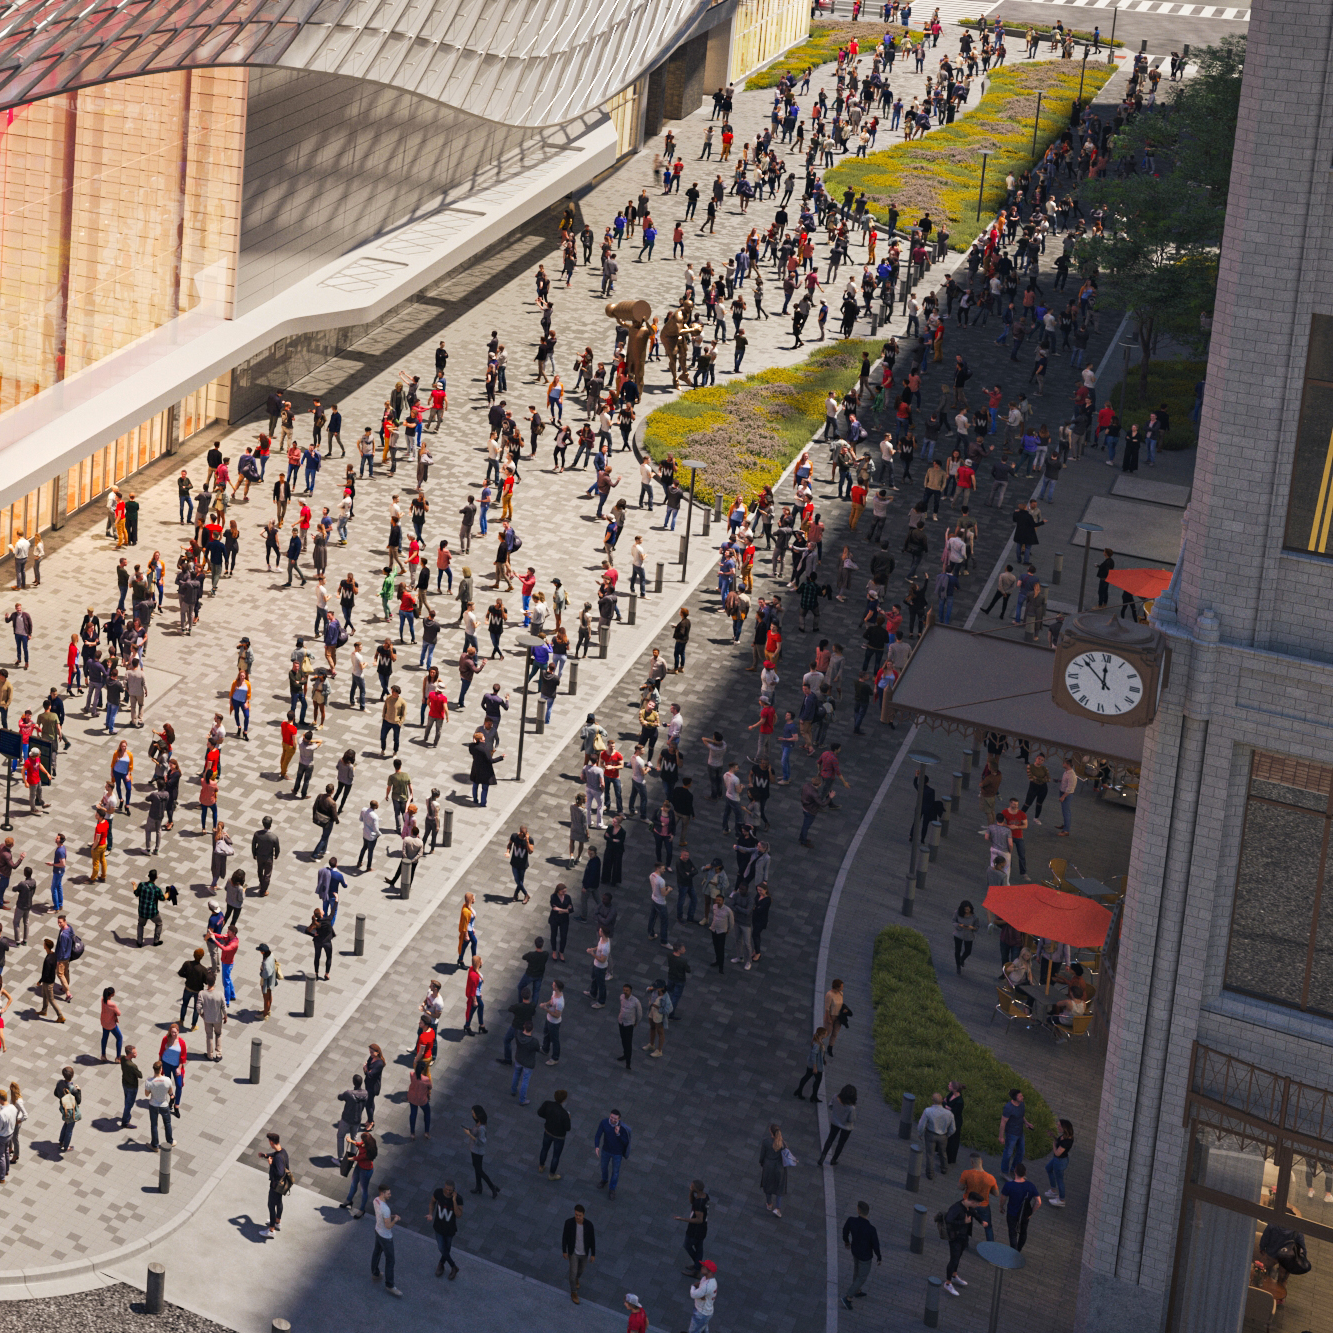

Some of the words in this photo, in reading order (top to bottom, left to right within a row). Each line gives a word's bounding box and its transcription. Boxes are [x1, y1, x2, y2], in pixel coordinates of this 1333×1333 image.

[664, 760, 676, 772] W
[755, 775, 768, 788] W
[513, 845, 526, 858] W
[438, 1204, 453, 1222] W
